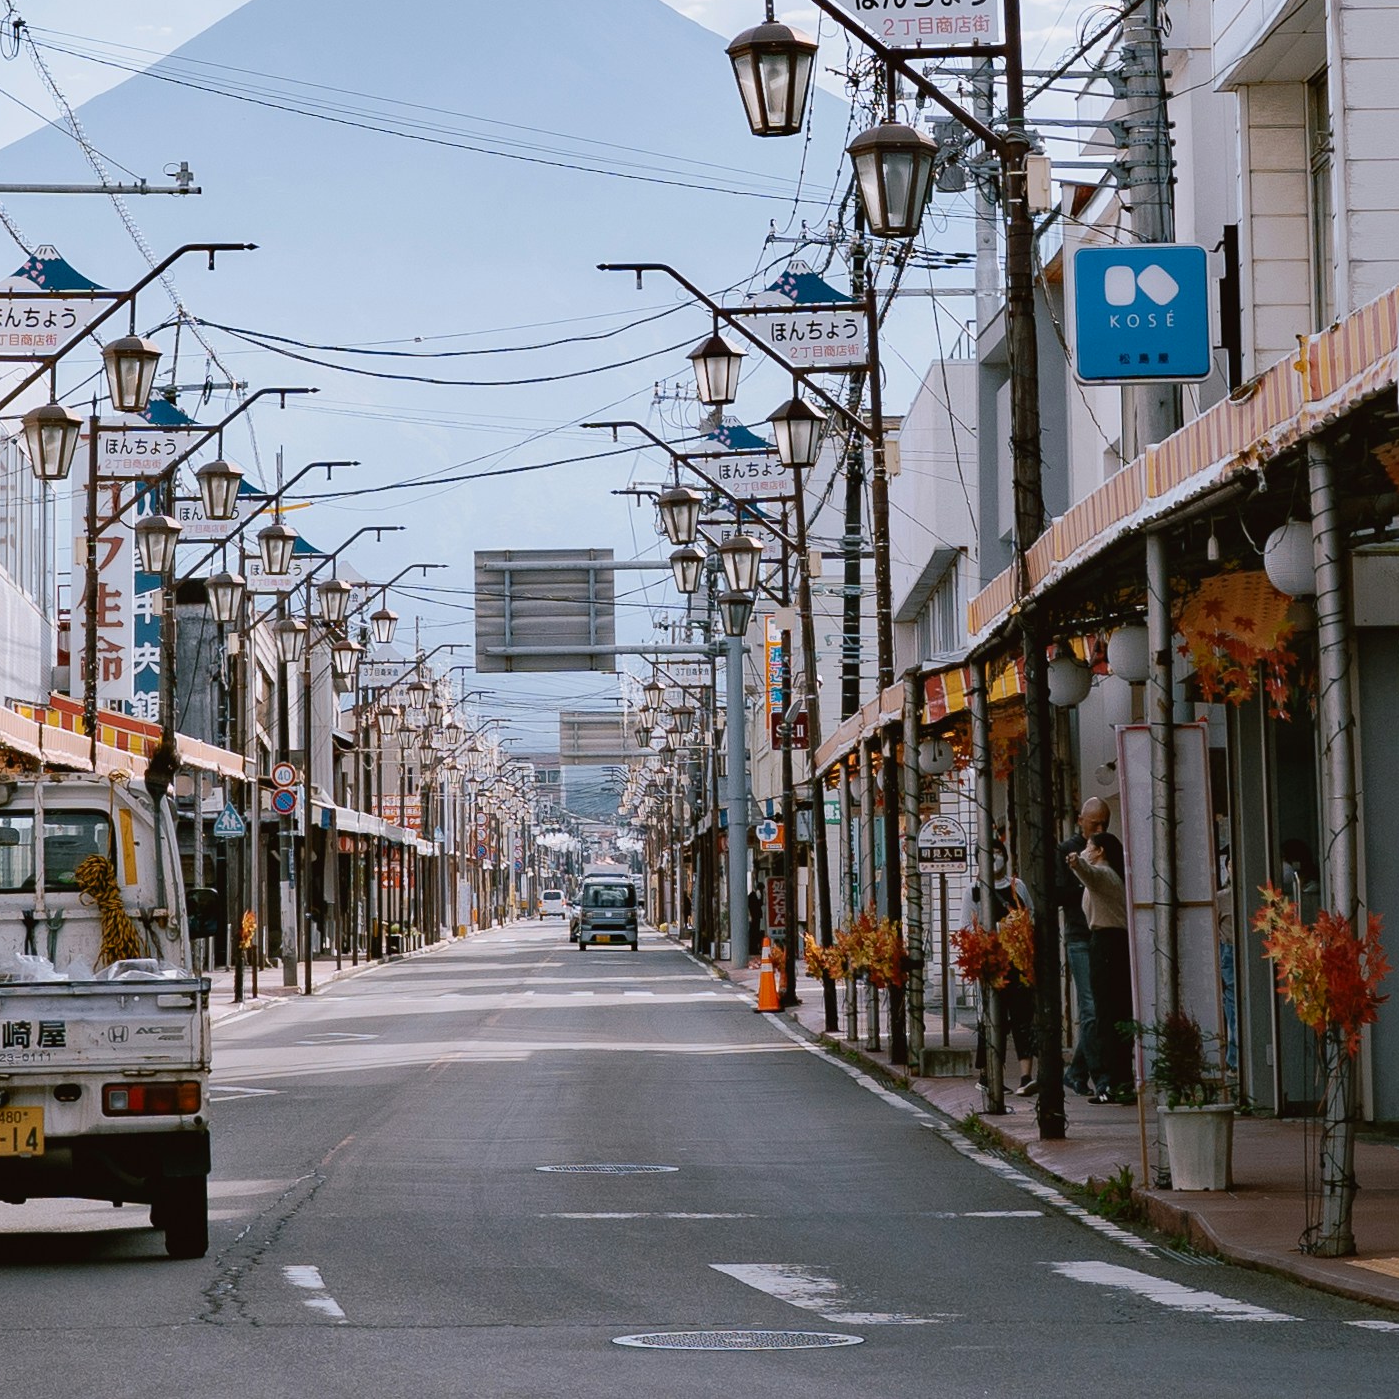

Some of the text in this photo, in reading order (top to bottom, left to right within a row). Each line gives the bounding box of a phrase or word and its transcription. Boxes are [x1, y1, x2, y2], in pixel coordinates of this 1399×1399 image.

[883, 15, 990, 36] 2丁目商店街
[1109, 309, 1175, 329] KOSÉ
[770, 317, 859, 343] ほんちょう
[790, 343, 860, 360] 2丁目商店街
[105, 438, 176, 456] ほんちょう
[718, 459, 787, 480] ほんちょう
[277, 769, 292, 782] 40
